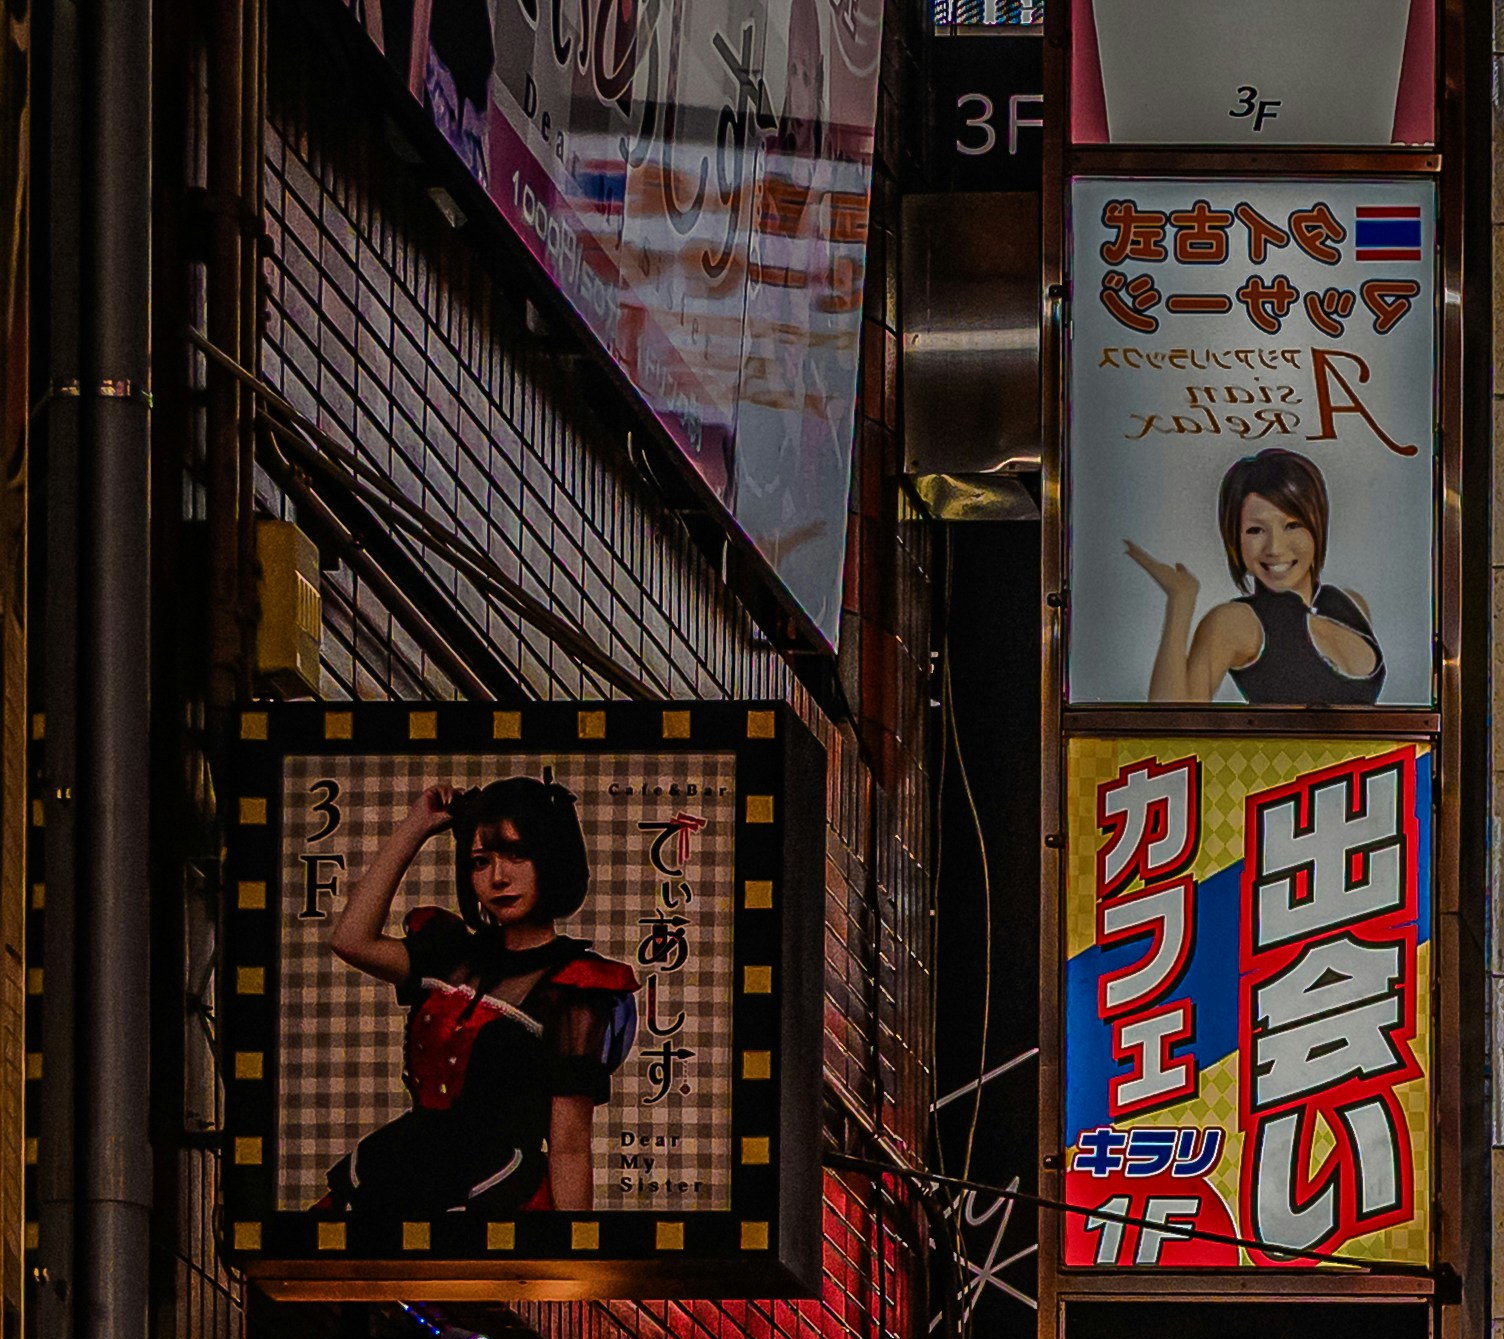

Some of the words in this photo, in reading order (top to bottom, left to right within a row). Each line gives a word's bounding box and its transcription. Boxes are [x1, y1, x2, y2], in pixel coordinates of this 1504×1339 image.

[955, 92, 1044, 155] 3F
[1229, 86, 1281, 131] 3F
[608, 783, 728, 798] Cafe&Bar
[1102, 765, 1191, 1106] カフェ
[1253, 766, 1402, 1264] 出会い
[620, 1133, 680, 1149] Dear
[620, 1156, 656, 1174] My
[1076, 1126, 1222, 1177] キラリ
[620, 1178, 704, 1194] Sister
[1086, 1194, 1202, 1264] 1F
